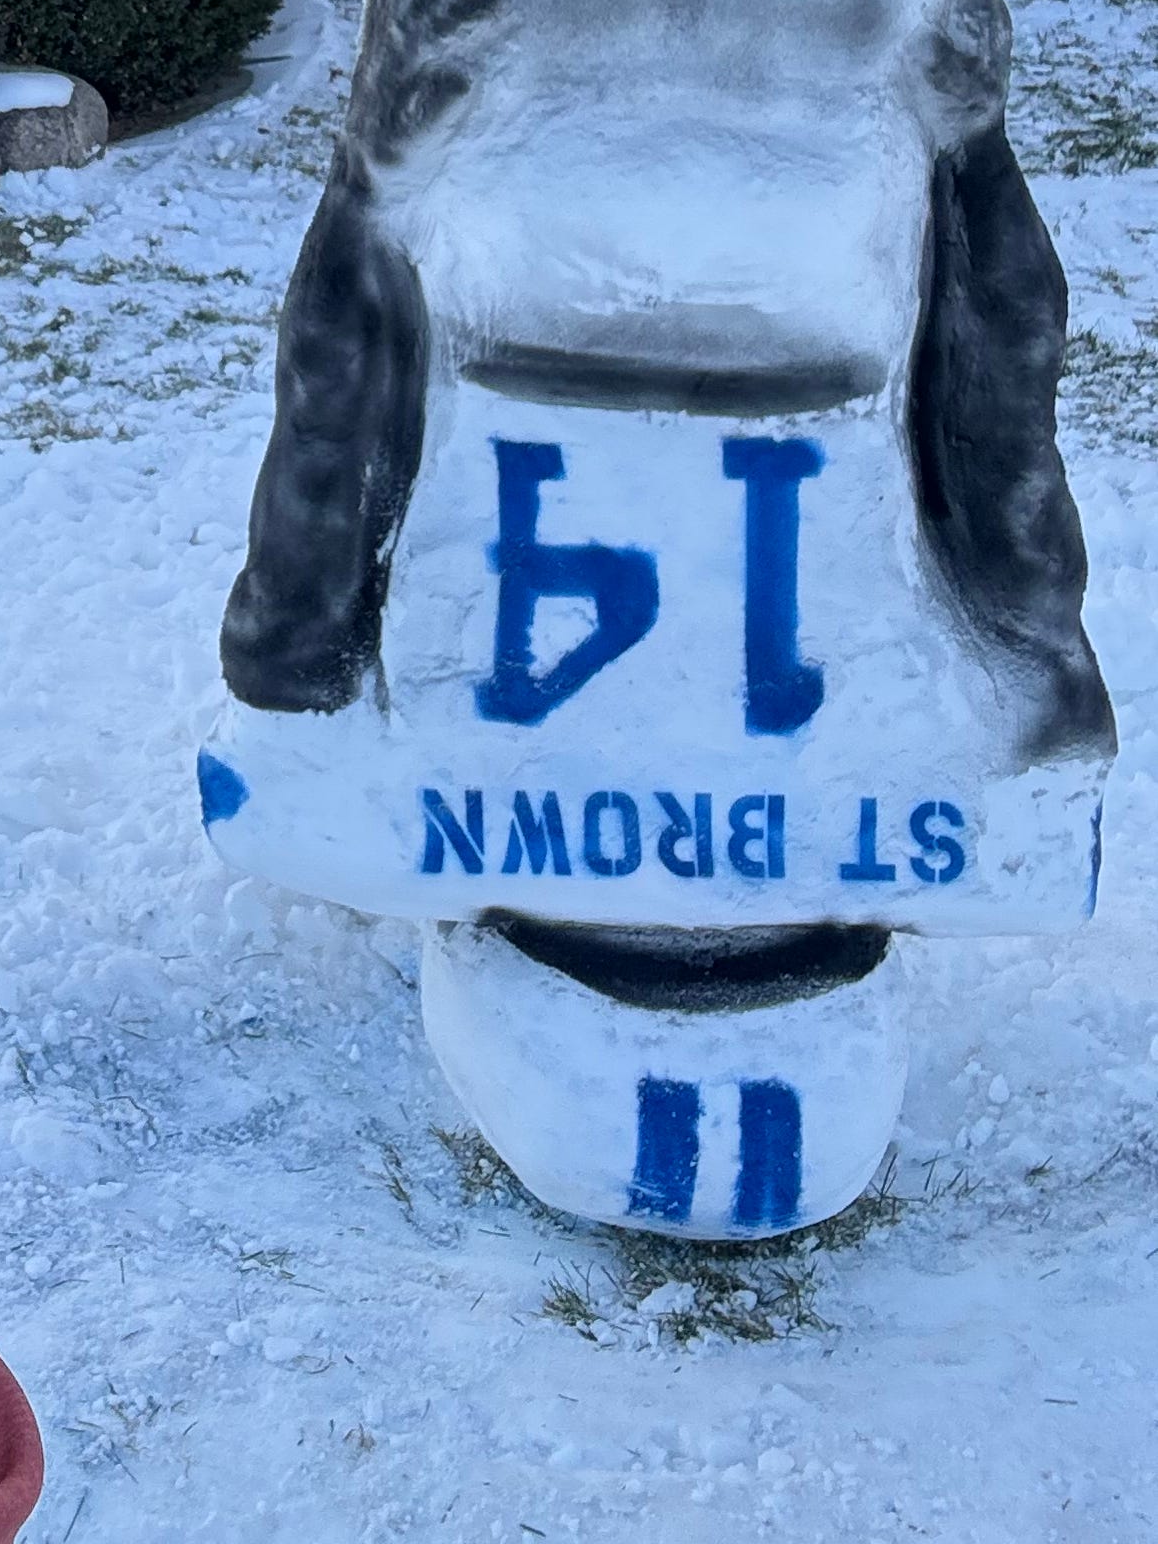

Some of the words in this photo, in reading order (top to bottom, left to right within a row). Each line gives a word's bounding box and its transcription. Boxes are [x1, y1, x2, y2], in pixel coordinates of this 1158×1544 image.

[470, 434, 827, 737] 14
[419, 787, 787, 881] BROWN
[838, 796, 968, 886] ST
